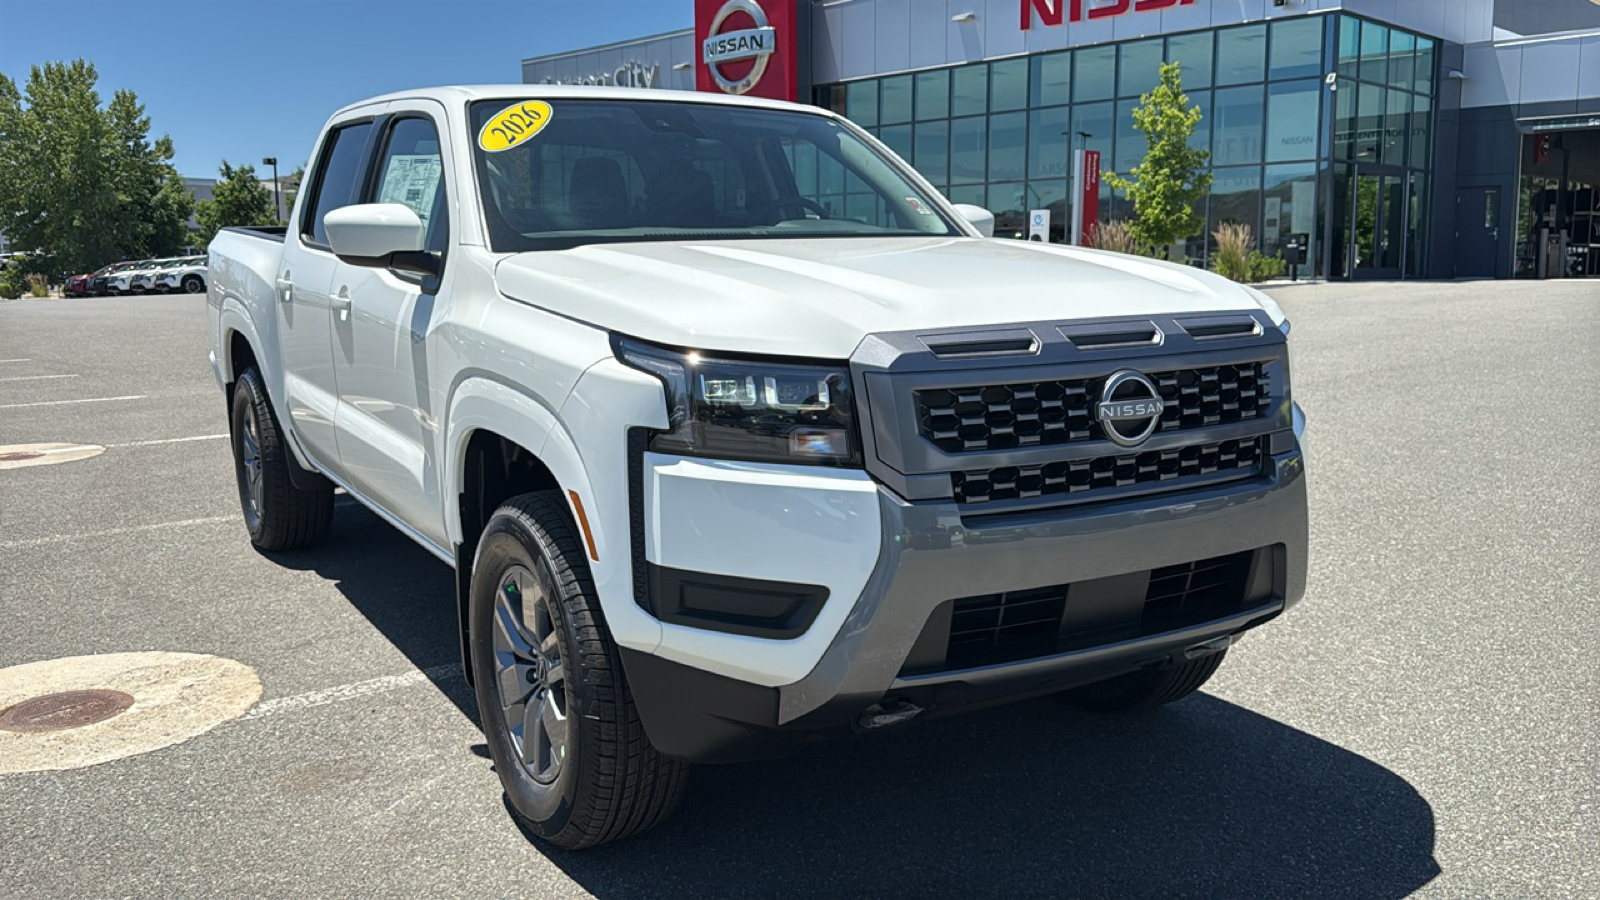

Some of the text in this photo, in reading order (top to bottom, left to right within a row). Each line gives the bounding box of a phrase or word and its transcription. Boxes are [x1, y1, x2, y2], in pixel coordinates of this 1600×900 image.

[706, 35, 763, 55] NISSAN
[491, 105, 541, 144] 2026
[1281, 136, 1314, 146] NISSAN
[1100, 402, 1163, 417] NISSAN
